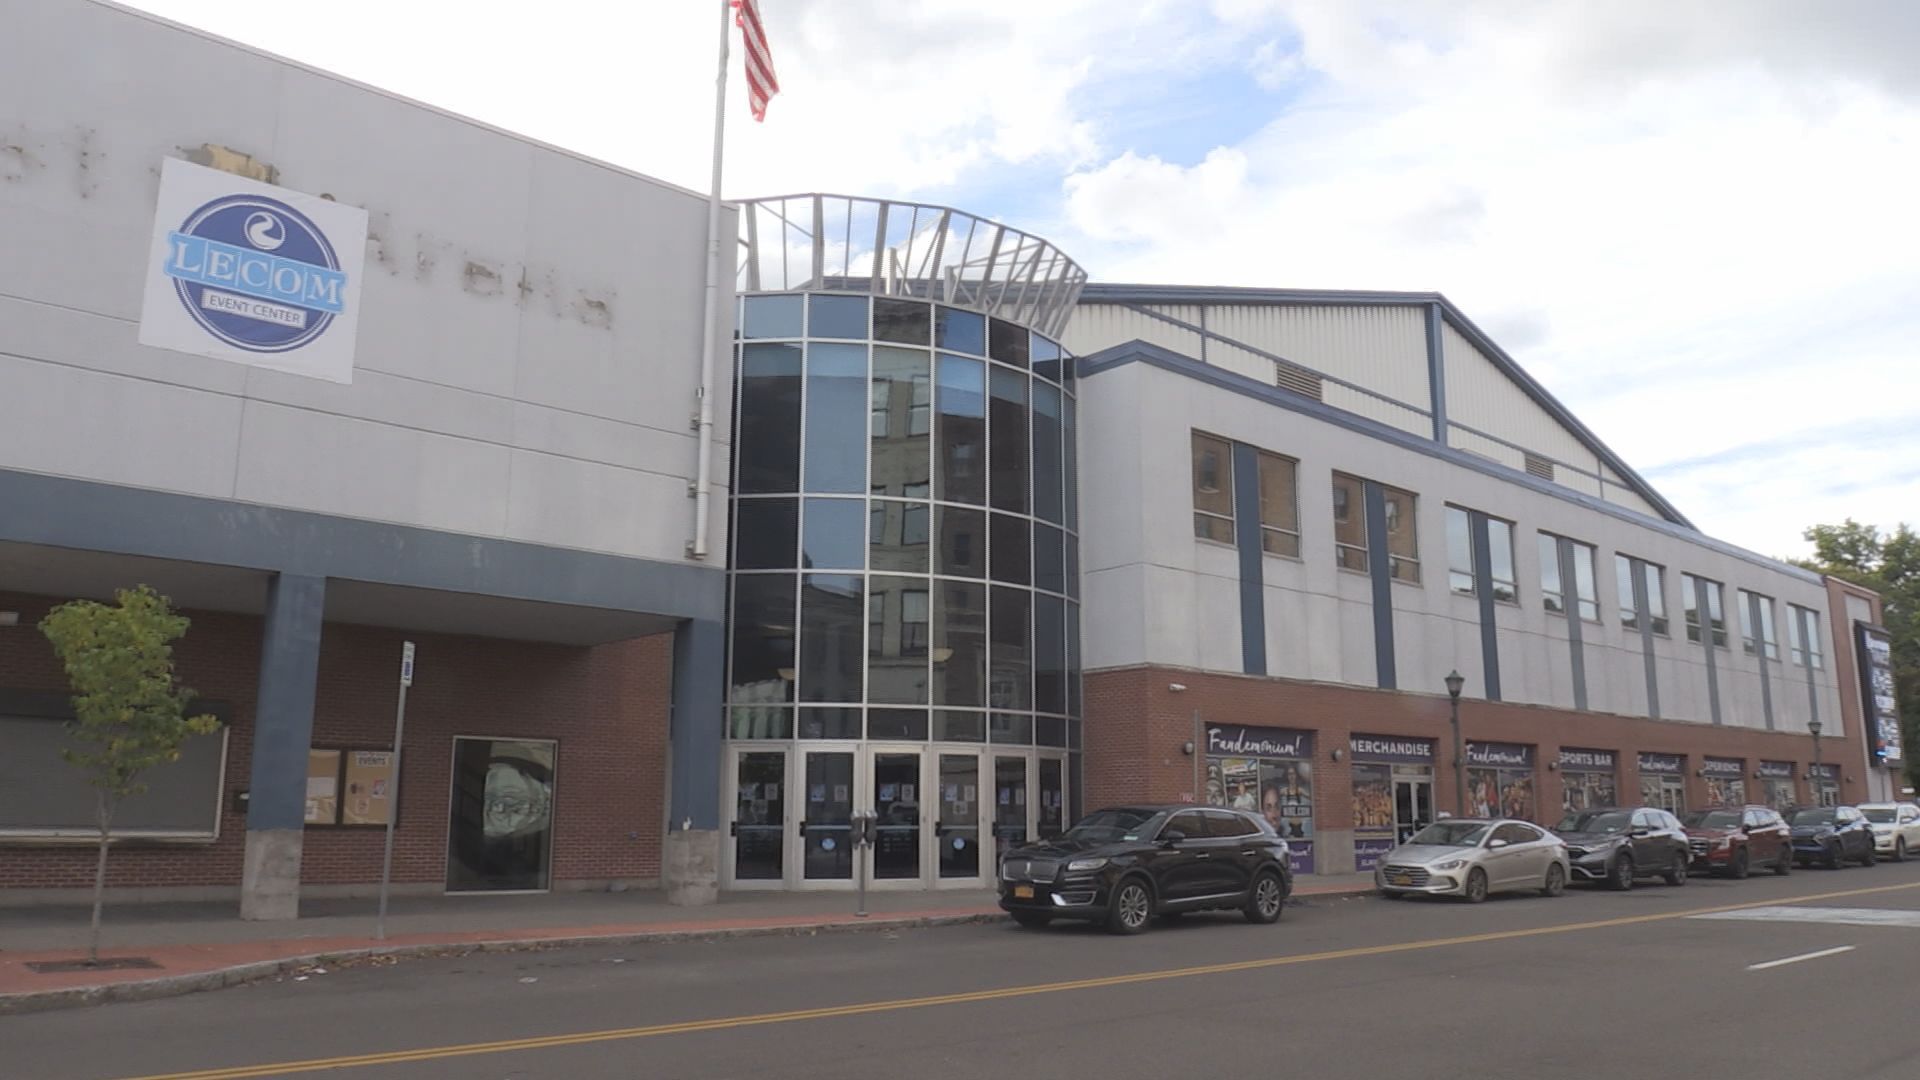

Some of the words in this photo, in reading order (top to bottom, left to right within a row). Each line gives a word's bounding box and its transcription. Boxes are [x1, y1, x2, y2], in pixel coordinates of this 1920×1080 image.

[173, 241, 341, 305] LECOM
[209, 294, 250, 313] EVENT
[252, 304, 301, 324] CENTER
[1595, 753, 1613, 767] BAR
